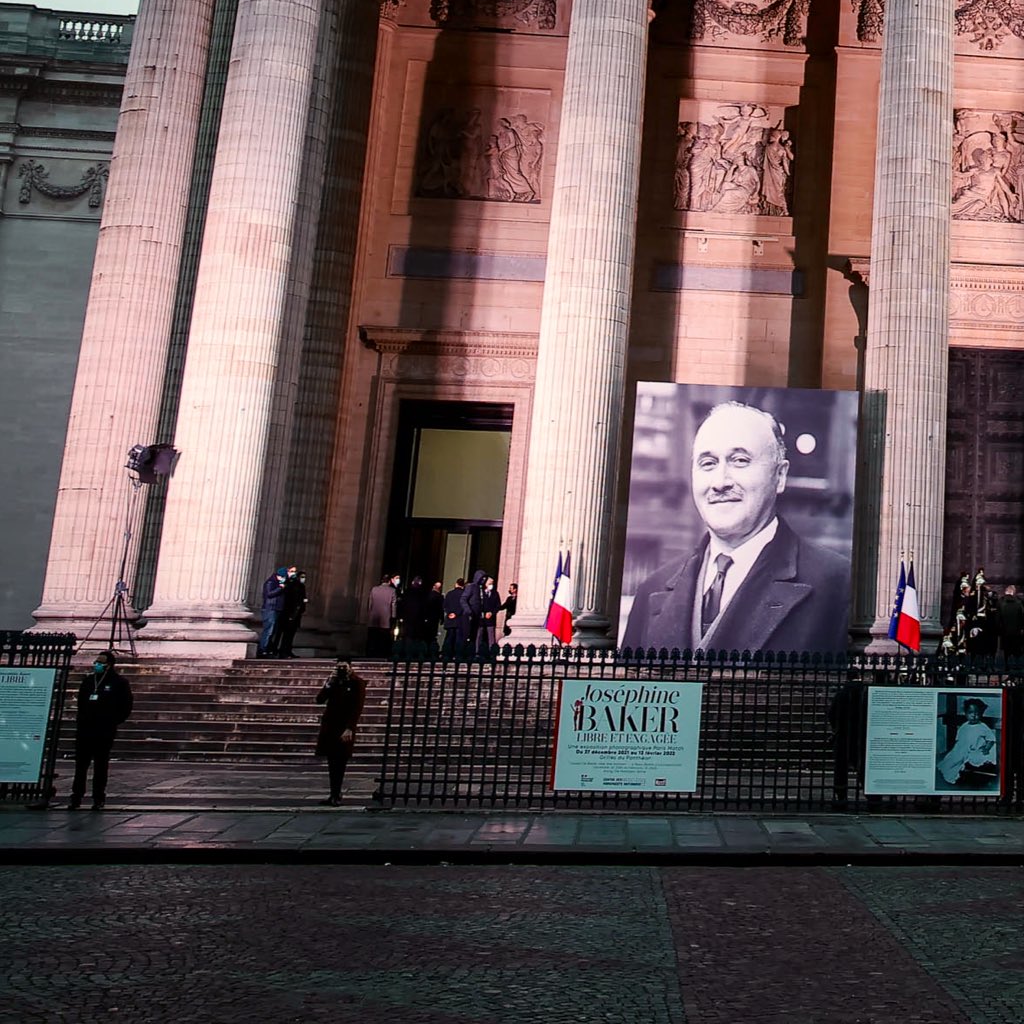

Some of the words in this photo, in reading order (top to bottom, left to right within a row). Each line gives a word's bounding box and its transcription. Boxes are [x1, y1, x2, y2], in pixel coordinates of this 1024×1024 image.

[581, 684, 680, 706] Joséphine
[578, 705, 679, 733] BAKER
[576, 733, 608, 743] LIBRE
[610, 733, 625, 743] ET
